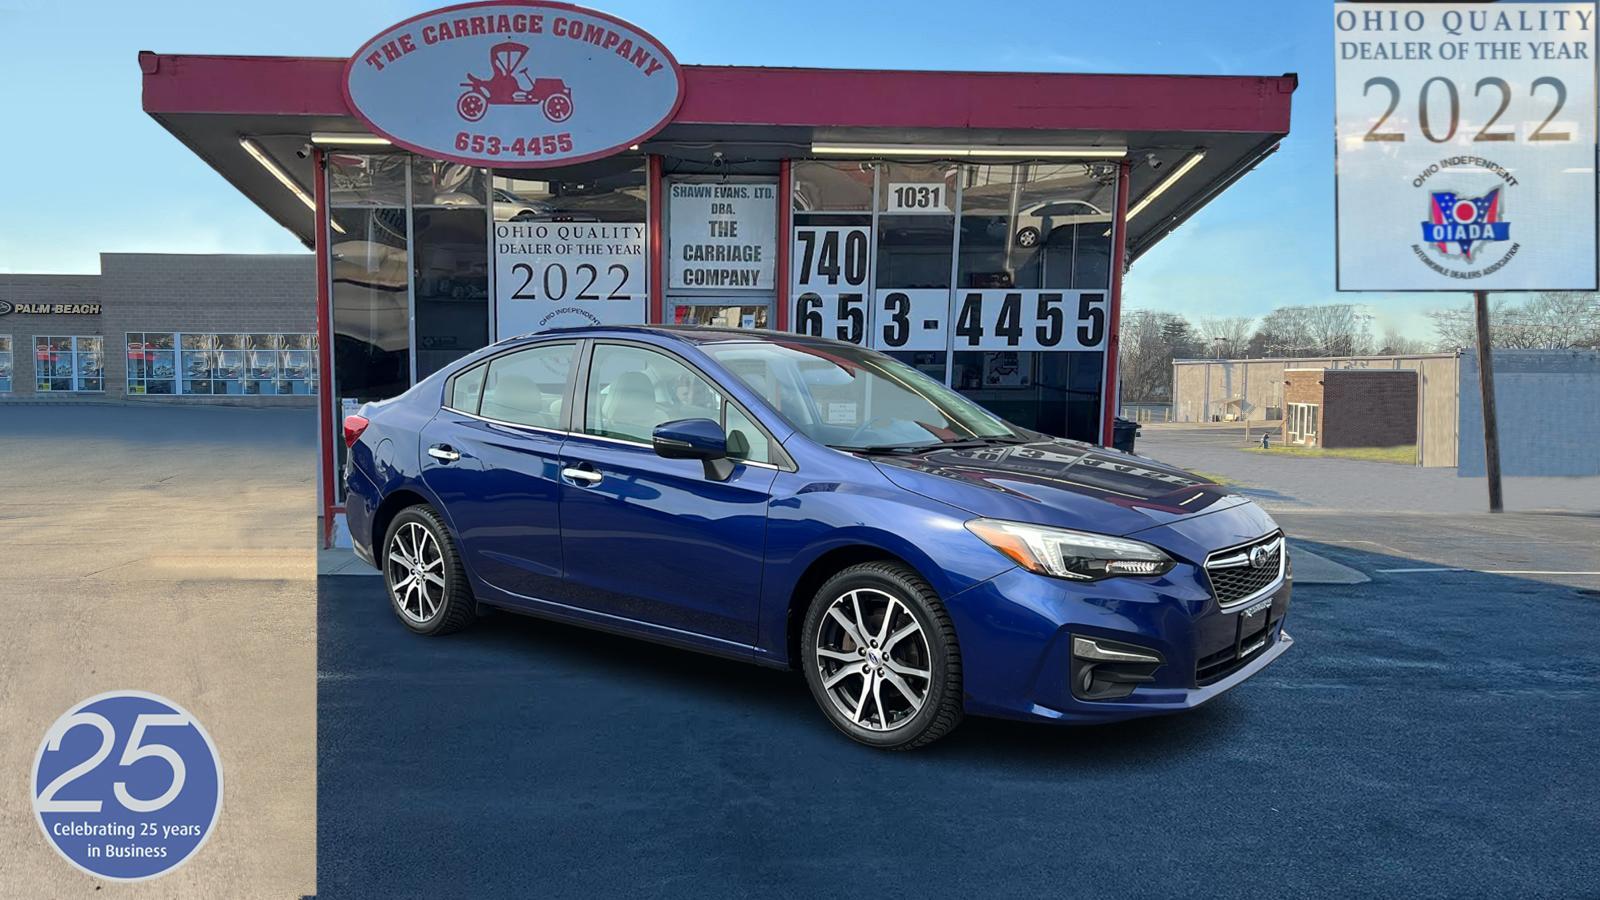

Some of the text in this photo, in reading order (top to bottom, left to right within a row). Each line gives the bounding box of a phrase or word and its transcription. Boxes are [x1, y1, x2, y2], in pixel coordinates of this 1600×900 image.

[1336, 10, 1592, 35] OHIO QUALITY
[365, 14, 664, 77] THE CARRIAGE COMPANY
[1340, 42, 1588, 60] DEALER OF THE YEAR
[1362, 76, 1571, 143] 2022
[455, 132, 573, 156] 653-4455
[1412, 156, 1519, 188] OHIO INDEPENDENT
[672, 186, 711, 198] SHAWN
[754, 187, 774, 199] LTD.
[894, 186, 940, 208] 1031
[711, 203, 736, 216] DBA.
[497, 226, 644, 241] OHIO QUALITY
[708, 220, 738, 238] THE
[1433, 224, 1494, 240] OIADA
[500, 244, 641, 255] DEALER OF THE YEAR
[683, 244, 762, 262] CARRIAGE
[798, 230, 867, 286] 740
[1411, 242, 1520, 280] AUTOMOBILE DEALERS ASSOCIATION
[510, 263, 632, 301] 2022
[683, 268, 760, 286] COMPANY
[15, 304, 100, 314] PALM BEACH
[539, 307, 601, 326] OHIO INDEPENDENT
